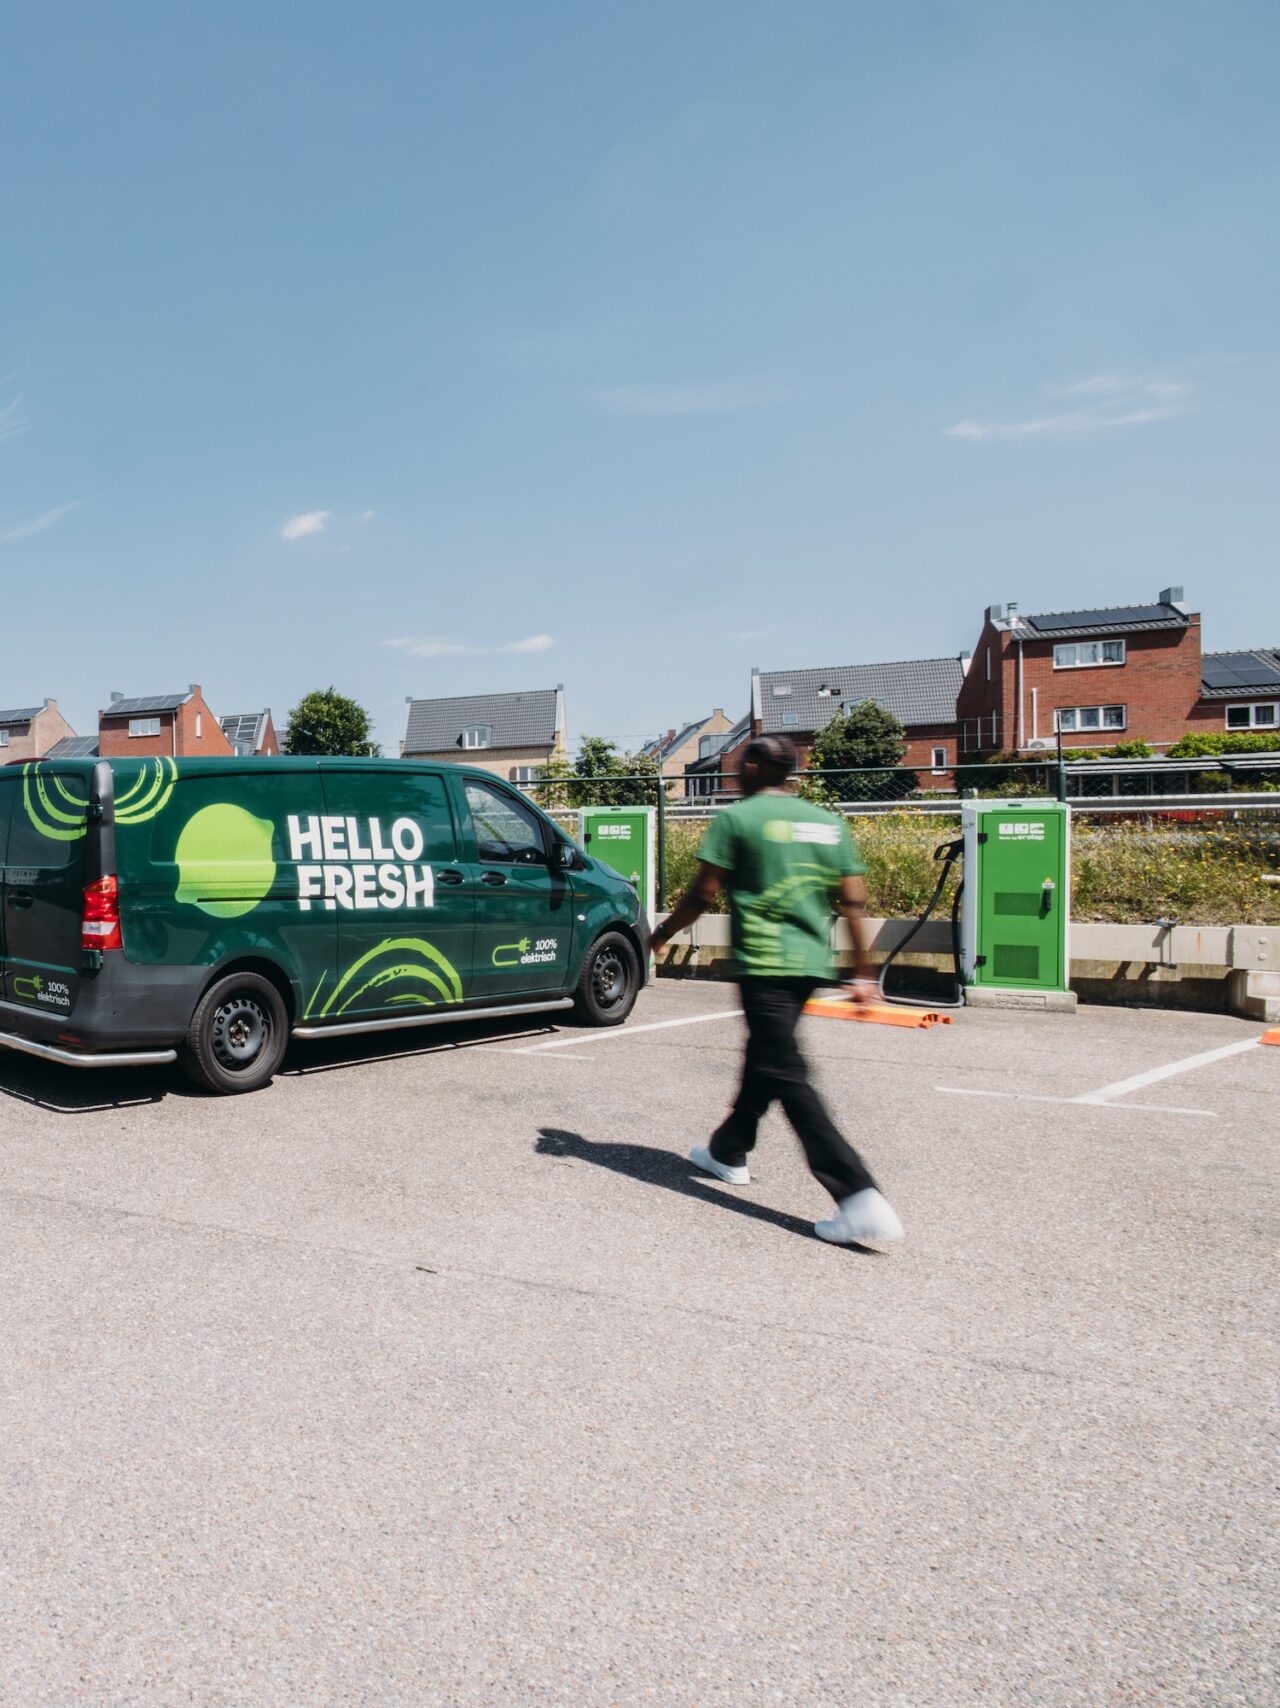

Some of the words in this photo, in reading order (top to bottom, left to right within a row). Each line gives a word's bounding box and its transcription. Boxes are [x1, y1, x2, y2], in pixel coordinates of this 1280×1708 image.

[287, 814, 424, 862] HELLO
[297, 863, 435, 911] FRESH
[535, 939, 558, 951] 100%
[520, 950, 557, 965] elektrisch
[47, 981, 70, 995] 100%
[36, 990, 71, 1007] elektrisch
